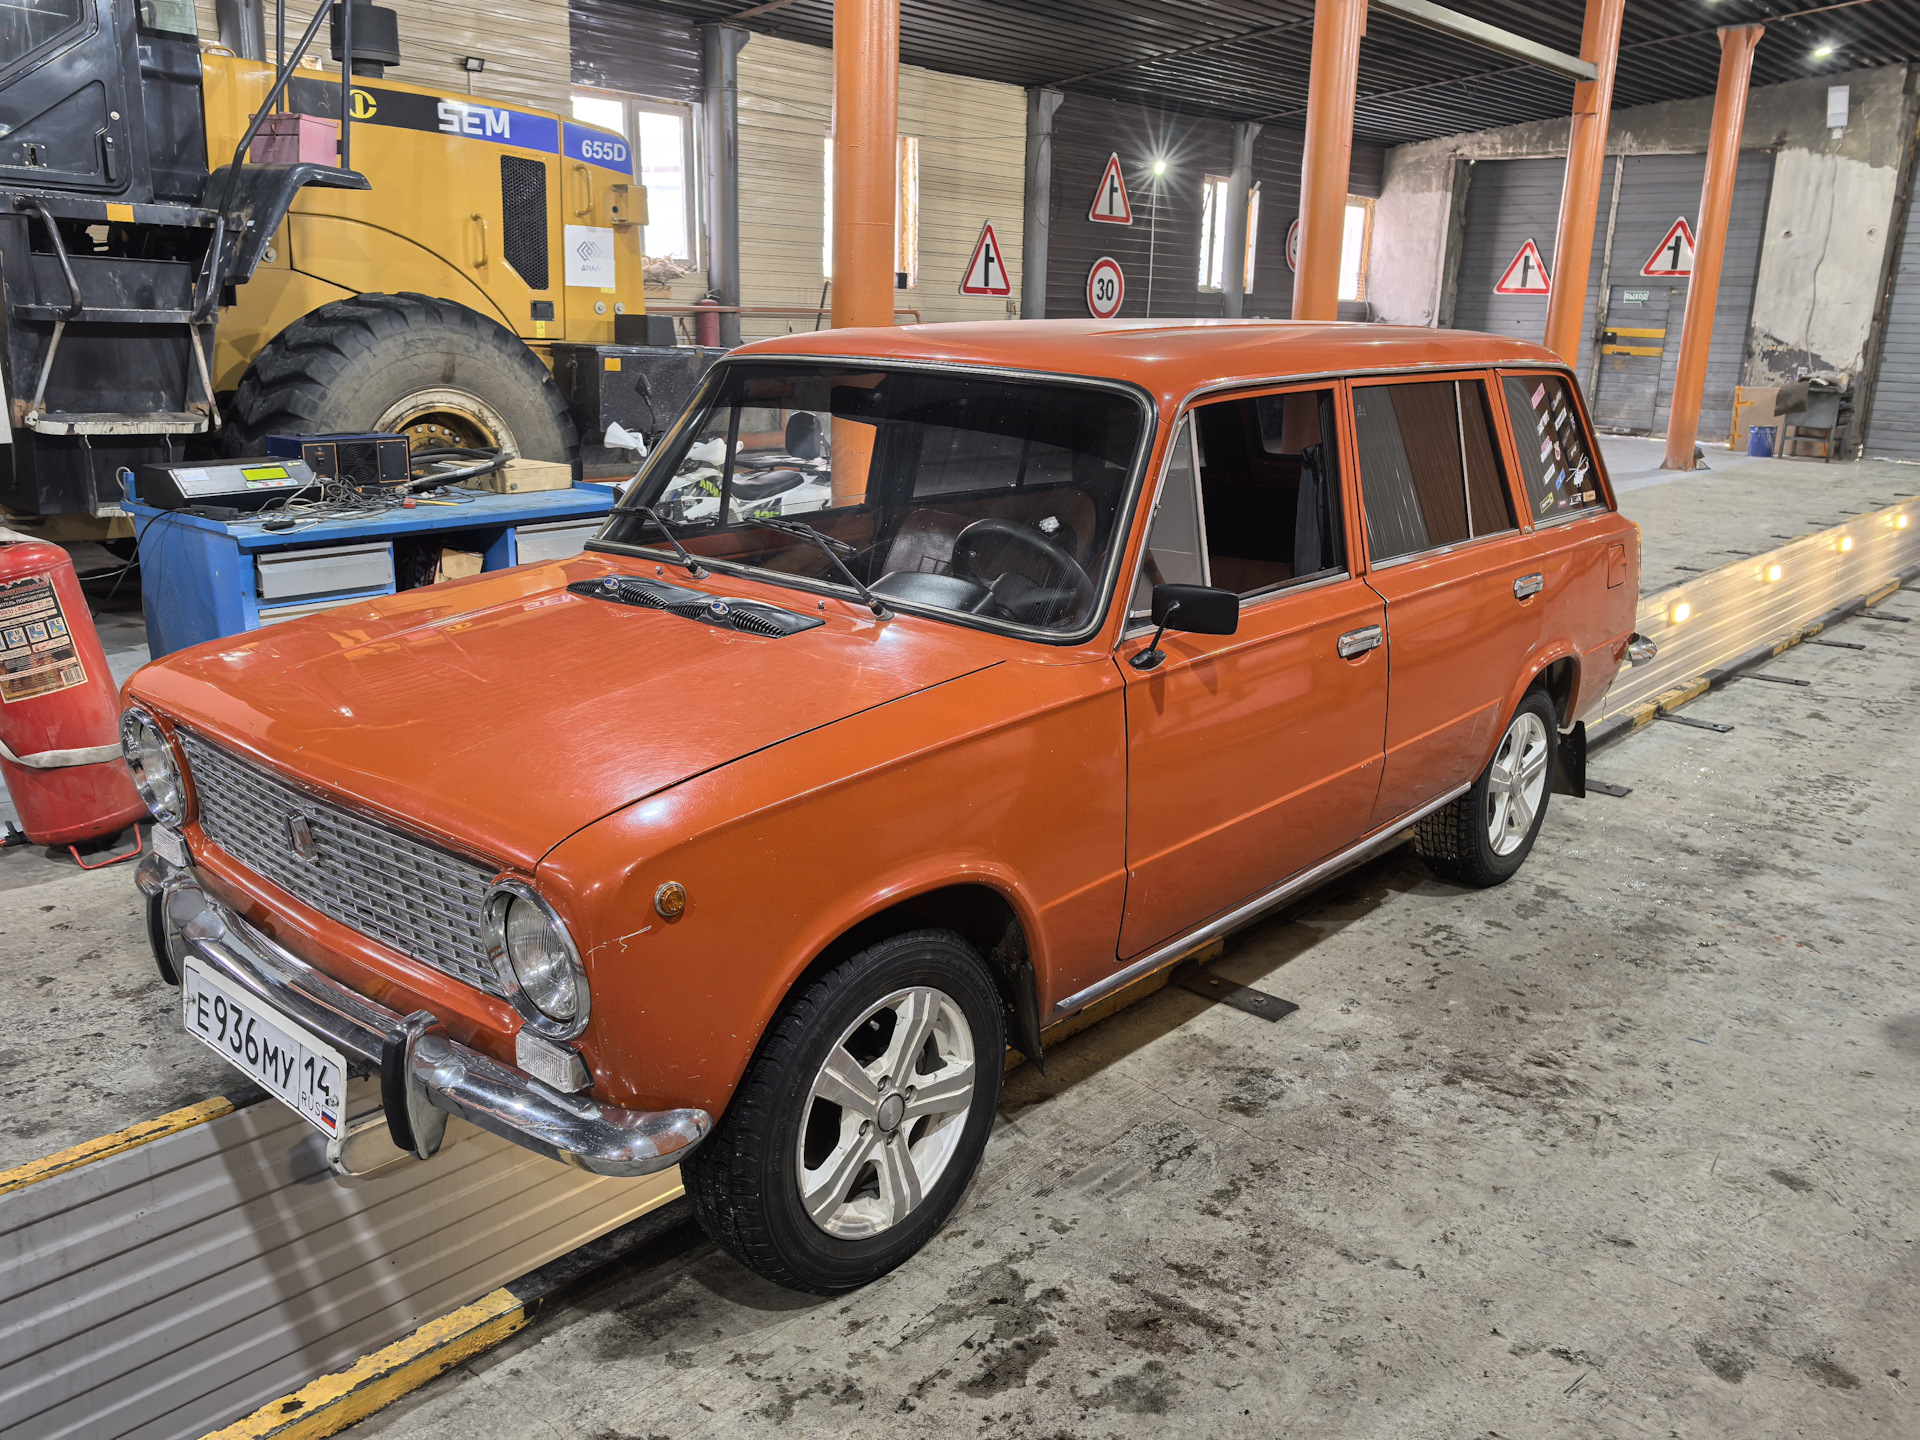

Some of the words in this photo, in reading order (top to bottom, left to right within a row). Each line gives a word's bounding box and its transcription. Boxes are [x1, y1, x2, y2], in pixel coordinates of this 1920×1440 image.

[437, 102, 510, 139] SEM
[581, 139, 627, 162] 655D
[1096, 278, 1114, 301] 30
[304, 1056, 330, 1106] 14
[301, 1091, 321, 1117] RUS
